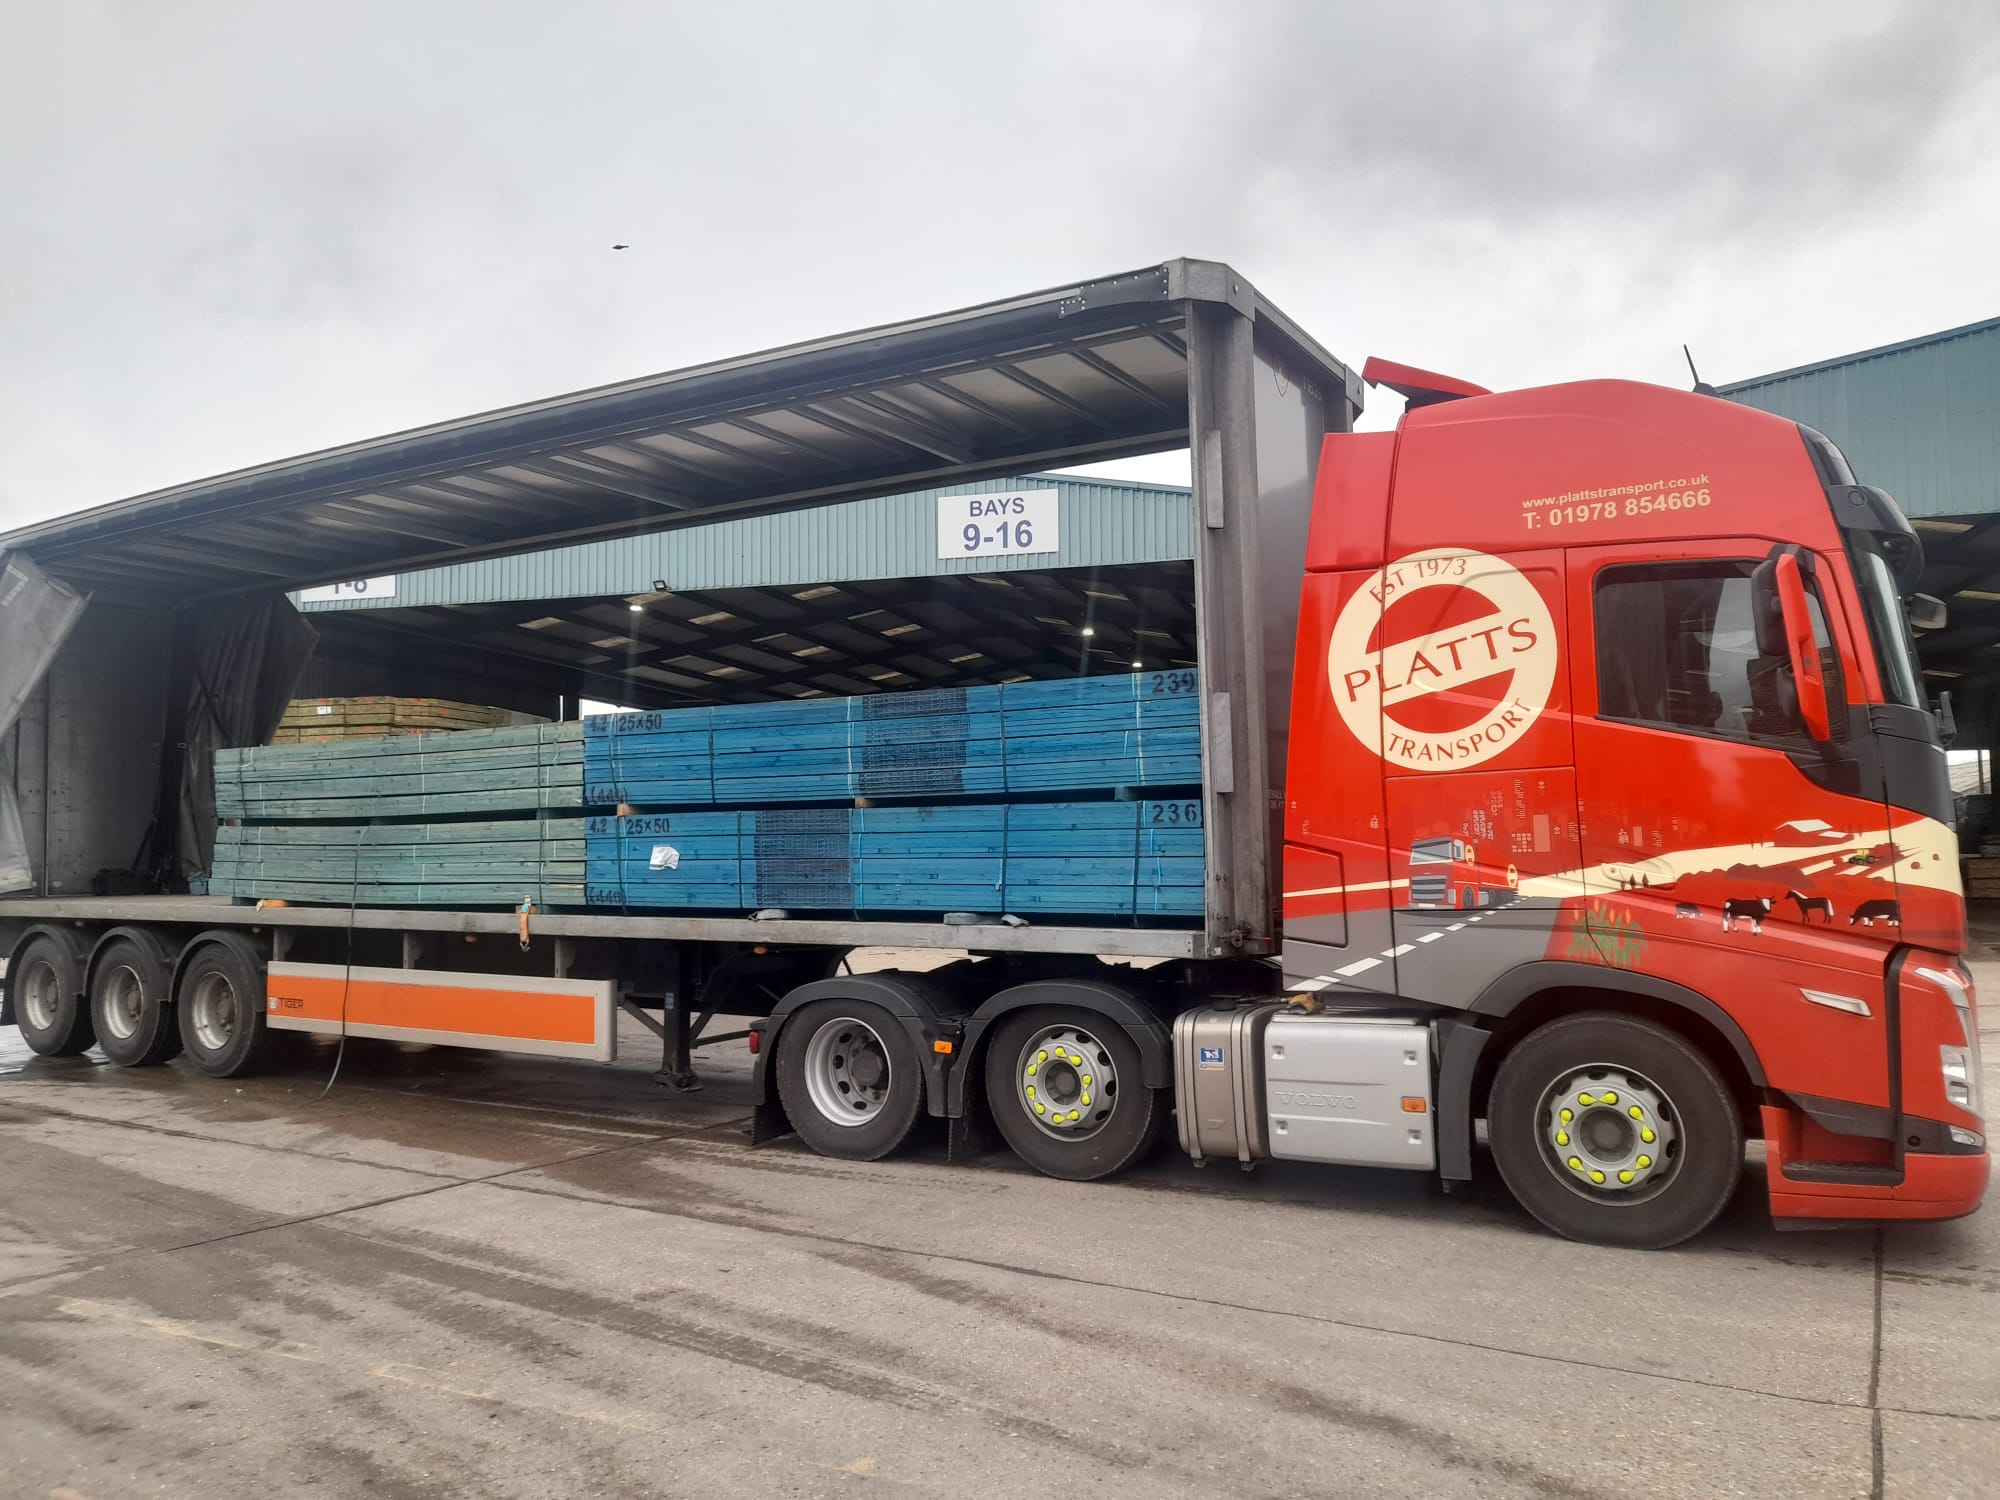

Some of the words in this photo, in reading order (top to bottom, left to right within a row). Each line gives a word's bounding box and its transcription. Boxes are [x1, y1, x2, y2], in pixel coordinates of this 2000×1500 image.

[969, 497, 1025, 517] BAYS
[1522, 473, 1710, 509] www.plattstransport.co.uk
[1522, 511, 1542, 530] T:
[1549, 501, 1618, 526] 01978
[1624, 488, 1712, 516] 854666
[962, 519, 1033, 552] 9-16
[1368, 567, 1407, 604] EST
[1413, 556, 1467, 580] 1973
[1343, 617, 1539, 704] PLATTS
[1386, 697, 1532, 763] TRANSPORT
[589, 817, 608, 833] 4.2
[1153, 803, 1198, 824] 236
[278, 997, 304, 1009] TIGER
[1272, 1091, 1361, 1110] VOLVO
